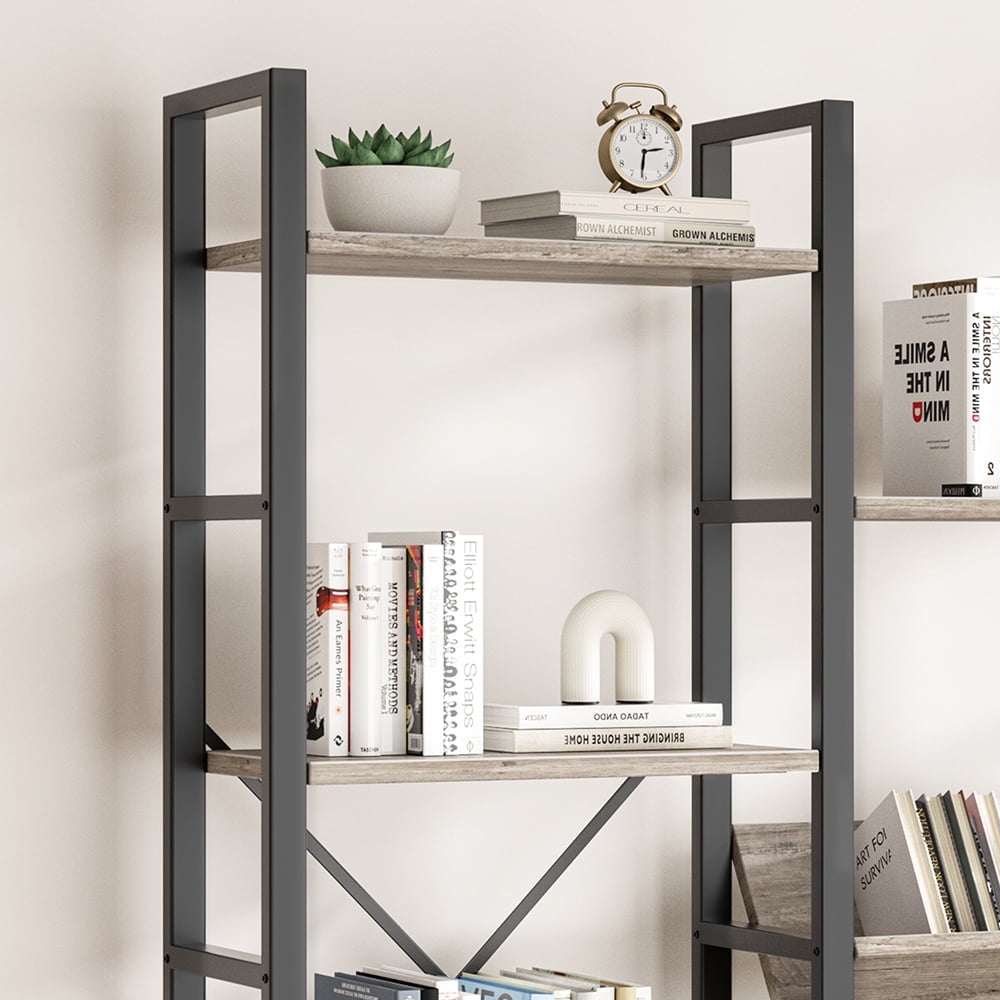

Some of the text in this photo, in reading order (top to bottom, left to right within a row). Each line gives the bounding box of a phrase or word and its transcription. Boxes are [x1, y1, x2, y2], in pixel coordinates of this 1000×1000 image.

[629, 125, 636, 133] 11
[641, 122, 648, 131] 12
[620, 134, 627, 142] 10
[623, 203, 690, 214] CEREAL
[577, 222, 657, 237] ROWN ALCHEMIST
[672, 229, 755, 243] GROWN ALCHEMIS
[463, 541, 477, 728] Elliott Erwitt Snaps
[388, 582, 398, 715] MOVIES AND METHODS
[335, 619, 343, 698] An Eames Primer
[856, 844, 871, 871] ART
